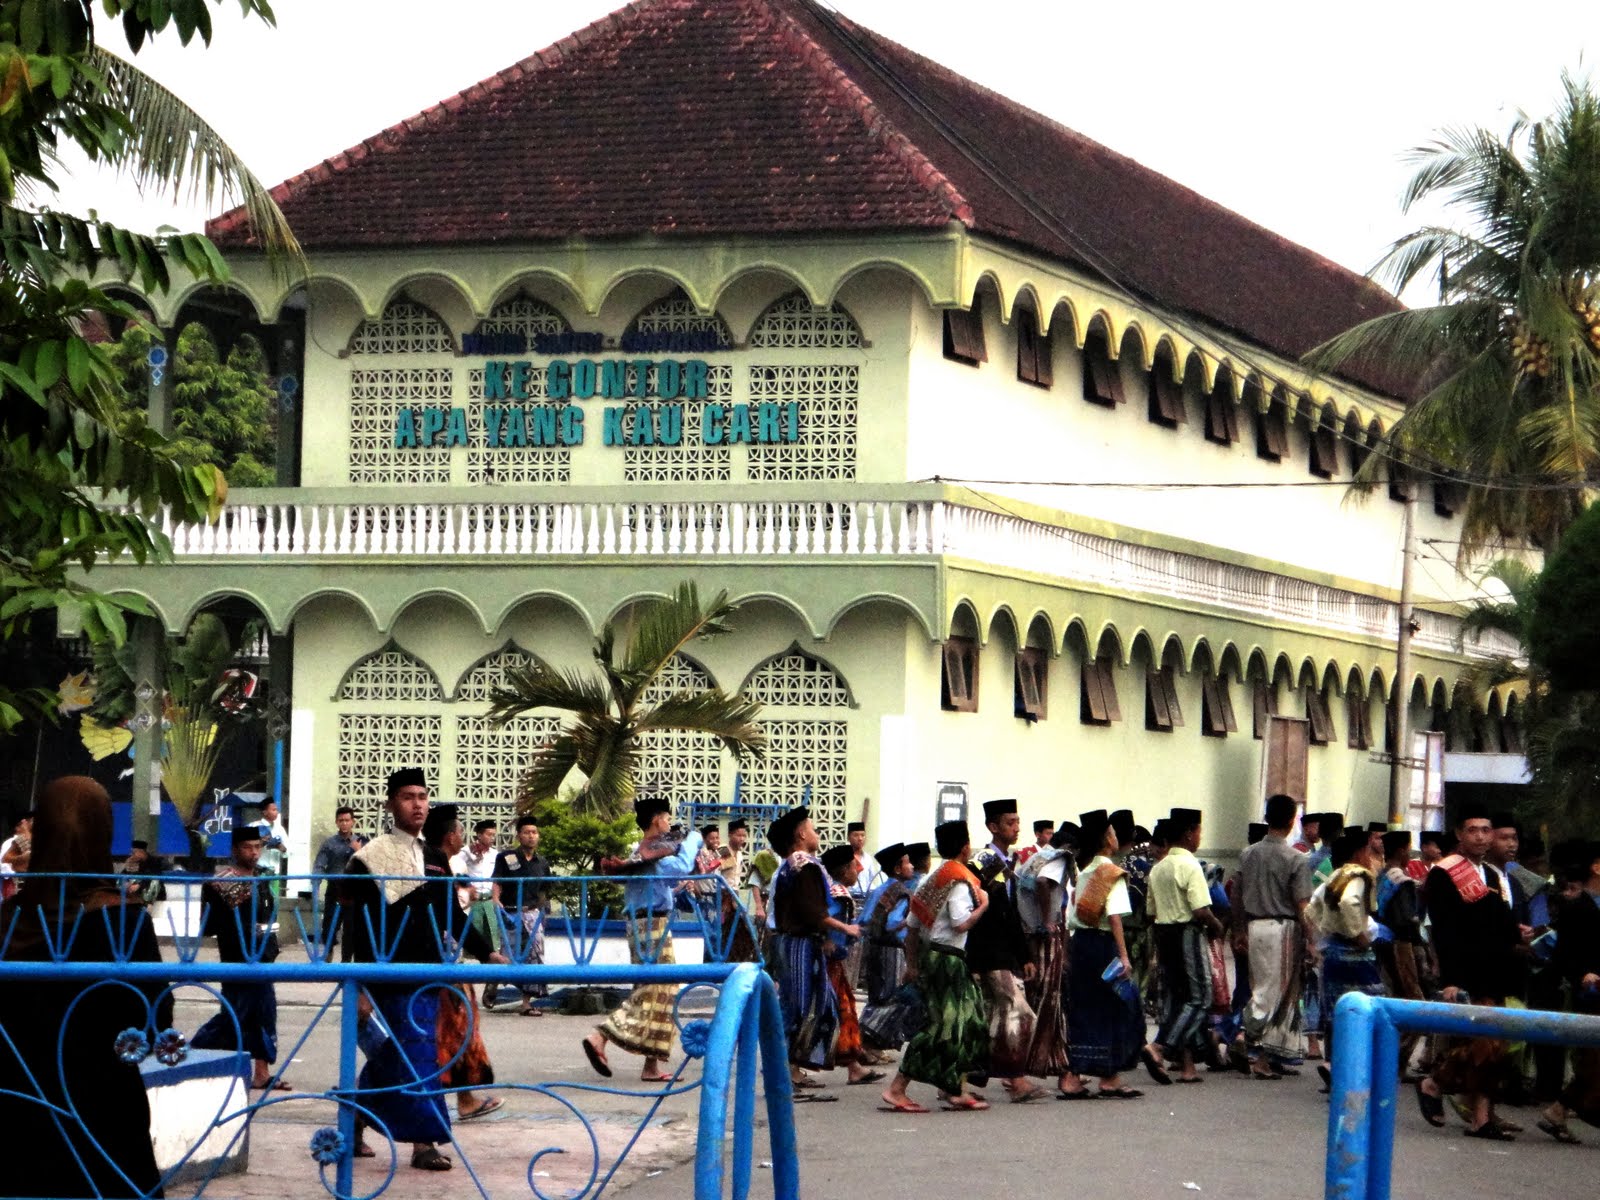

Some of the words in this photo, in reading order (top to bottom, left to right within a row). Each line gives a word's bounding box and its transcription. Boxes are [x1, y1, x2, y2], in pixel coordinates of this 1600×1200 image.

[485, 361, 531, 399] KE
[547, 359, 709, 399] GONTOR
[394, 407, 468, 448] APA
[481, 406, 585, 447] YANG
[602, 407, 684, 447] KAU
[702, 402, 800, 446] CARI
